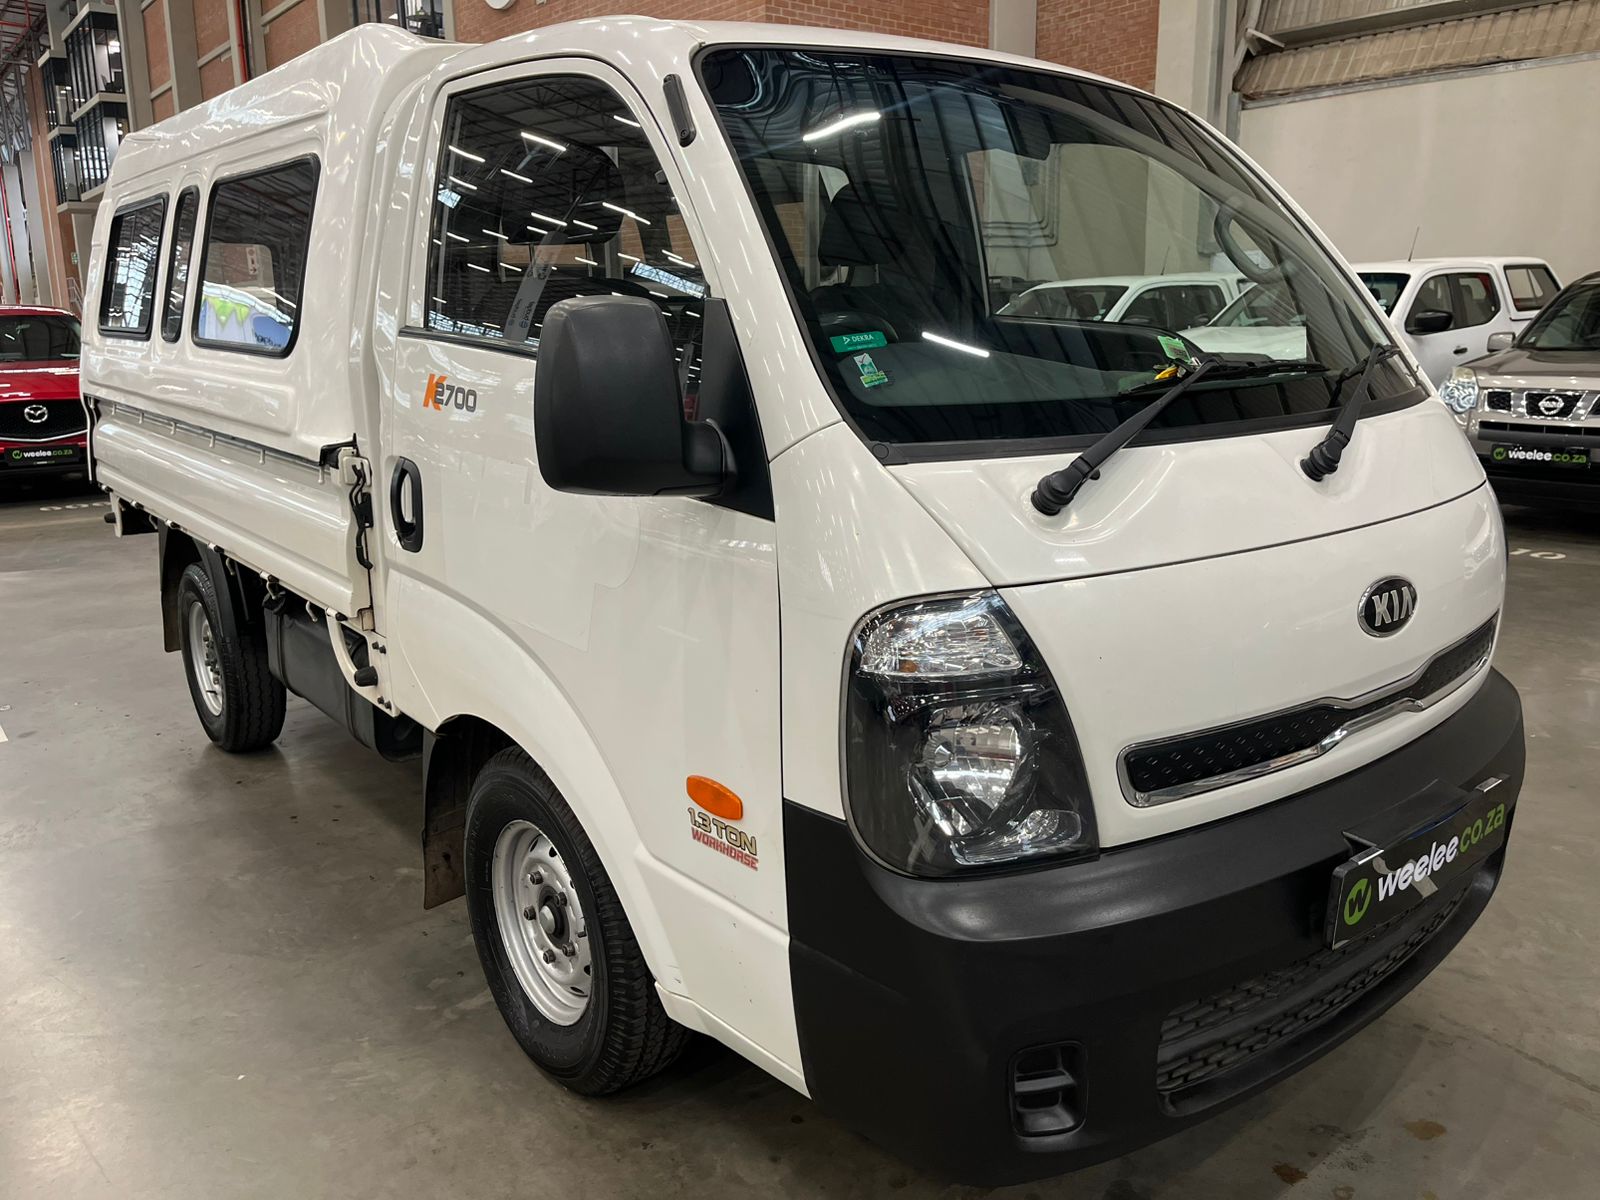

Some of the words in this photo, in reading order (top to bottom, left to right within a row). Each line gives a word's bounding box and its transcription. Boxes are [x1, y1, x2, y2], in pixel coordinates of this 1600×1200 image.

[851, 334, 874, 342] DEKRA
[1371, 586, 1413, 627] KIA
[687, 806, 712, 833] 1.3
[712, 818, 757, 856] TON
[690, 826, 759, 872] WORKHORSE
[1377, 803, 1506, 902] weelee.co.za
